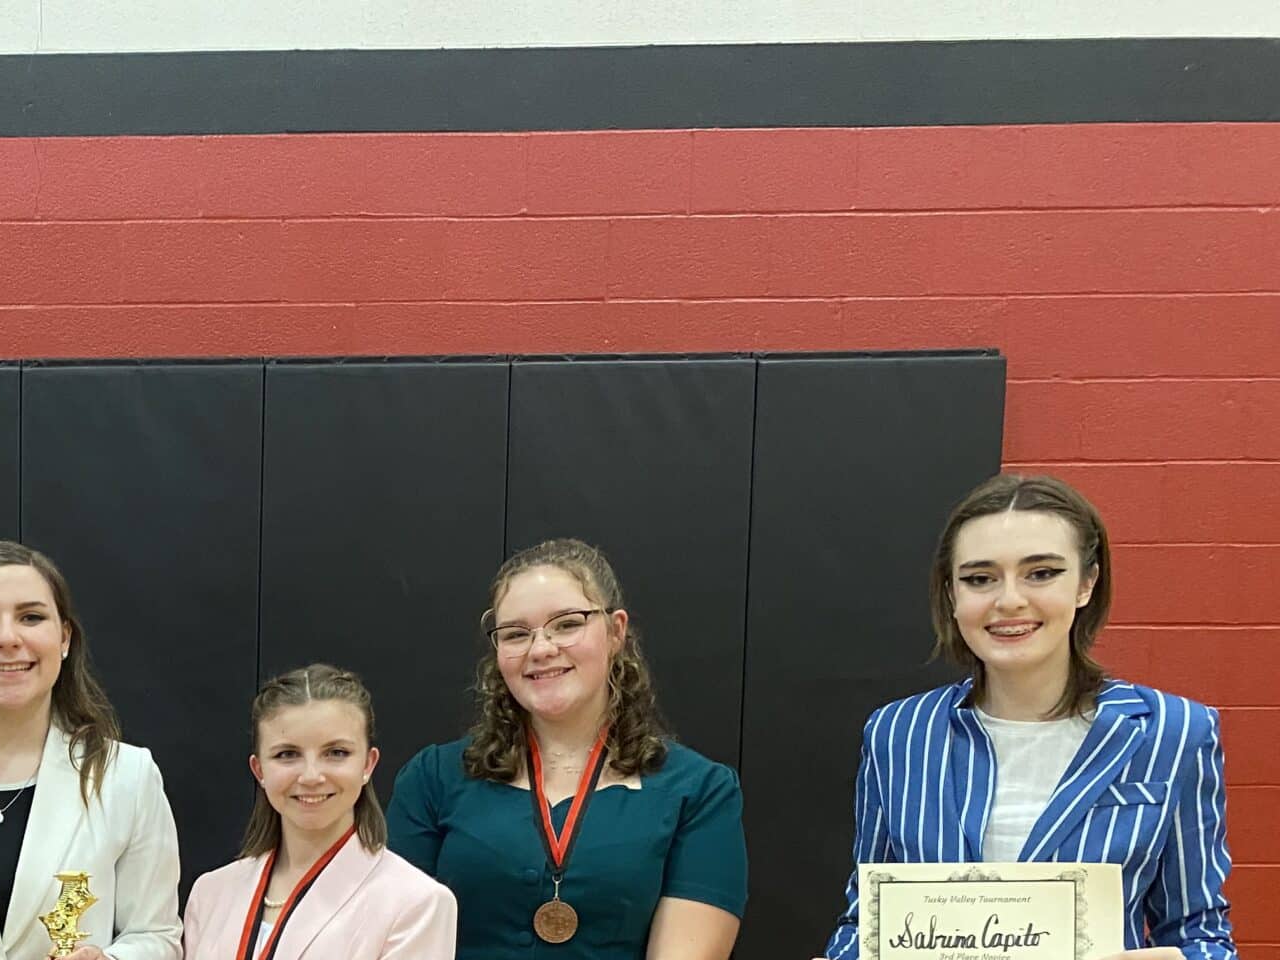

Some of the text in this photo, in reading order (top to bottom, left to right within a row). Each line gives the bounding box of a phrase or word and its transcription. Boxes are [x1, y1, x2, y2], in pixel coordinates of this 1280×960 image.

[978, 895, 1032, 904] Tournament
[889, 912, 1050, 953] Sabrina Capito
[956, 953, 979, 960] Place
